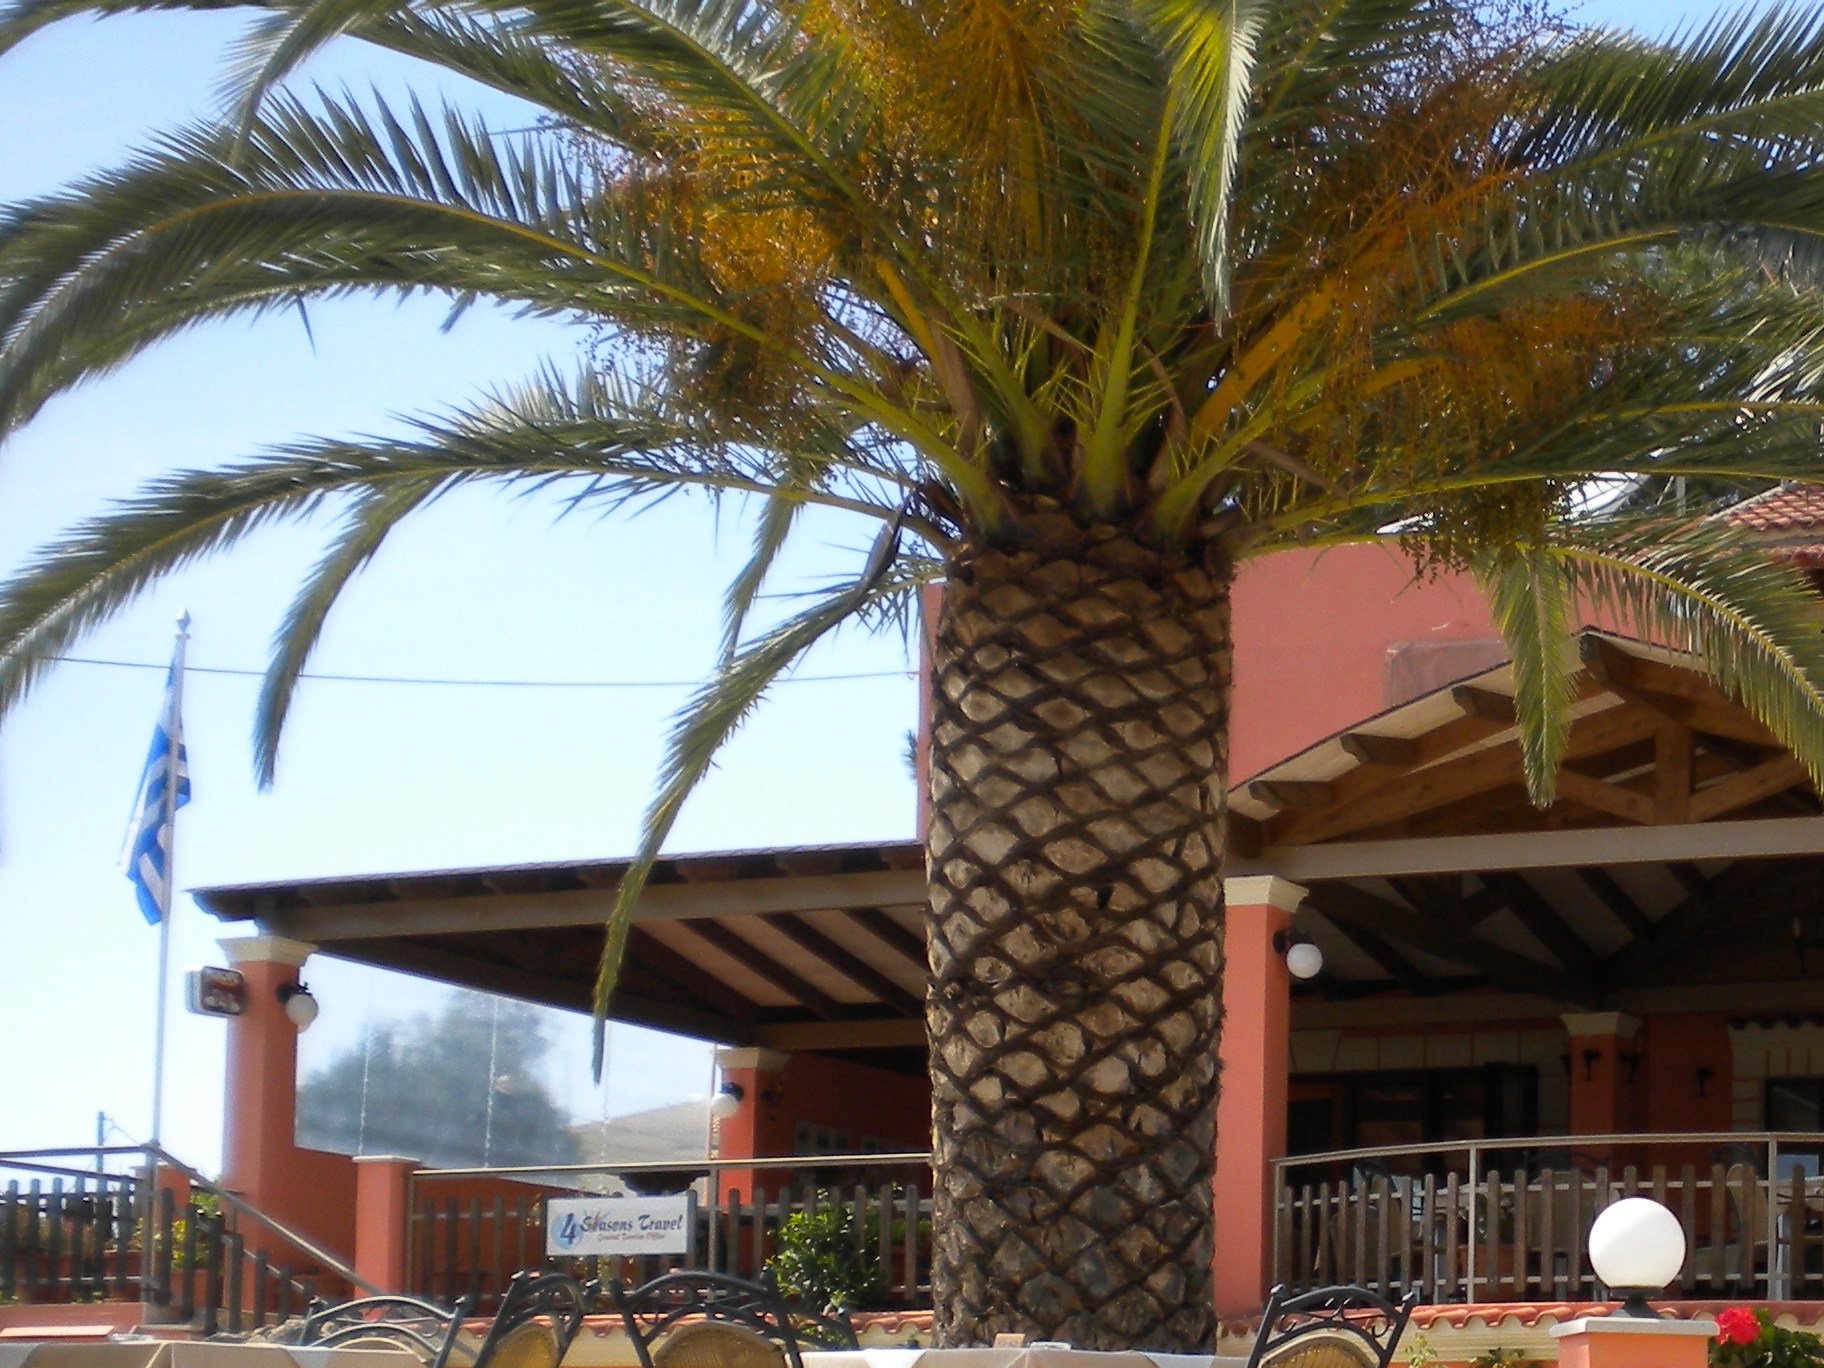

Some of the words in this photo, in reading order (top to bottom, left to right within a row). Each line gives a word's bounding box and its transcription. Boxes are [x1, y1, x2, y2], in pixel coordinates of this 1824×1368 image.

[560, 1213, 577, 1245] 4
[580, 1213, 633, 1232] Seasons
[638, 1214, 683, 1231] Travel
